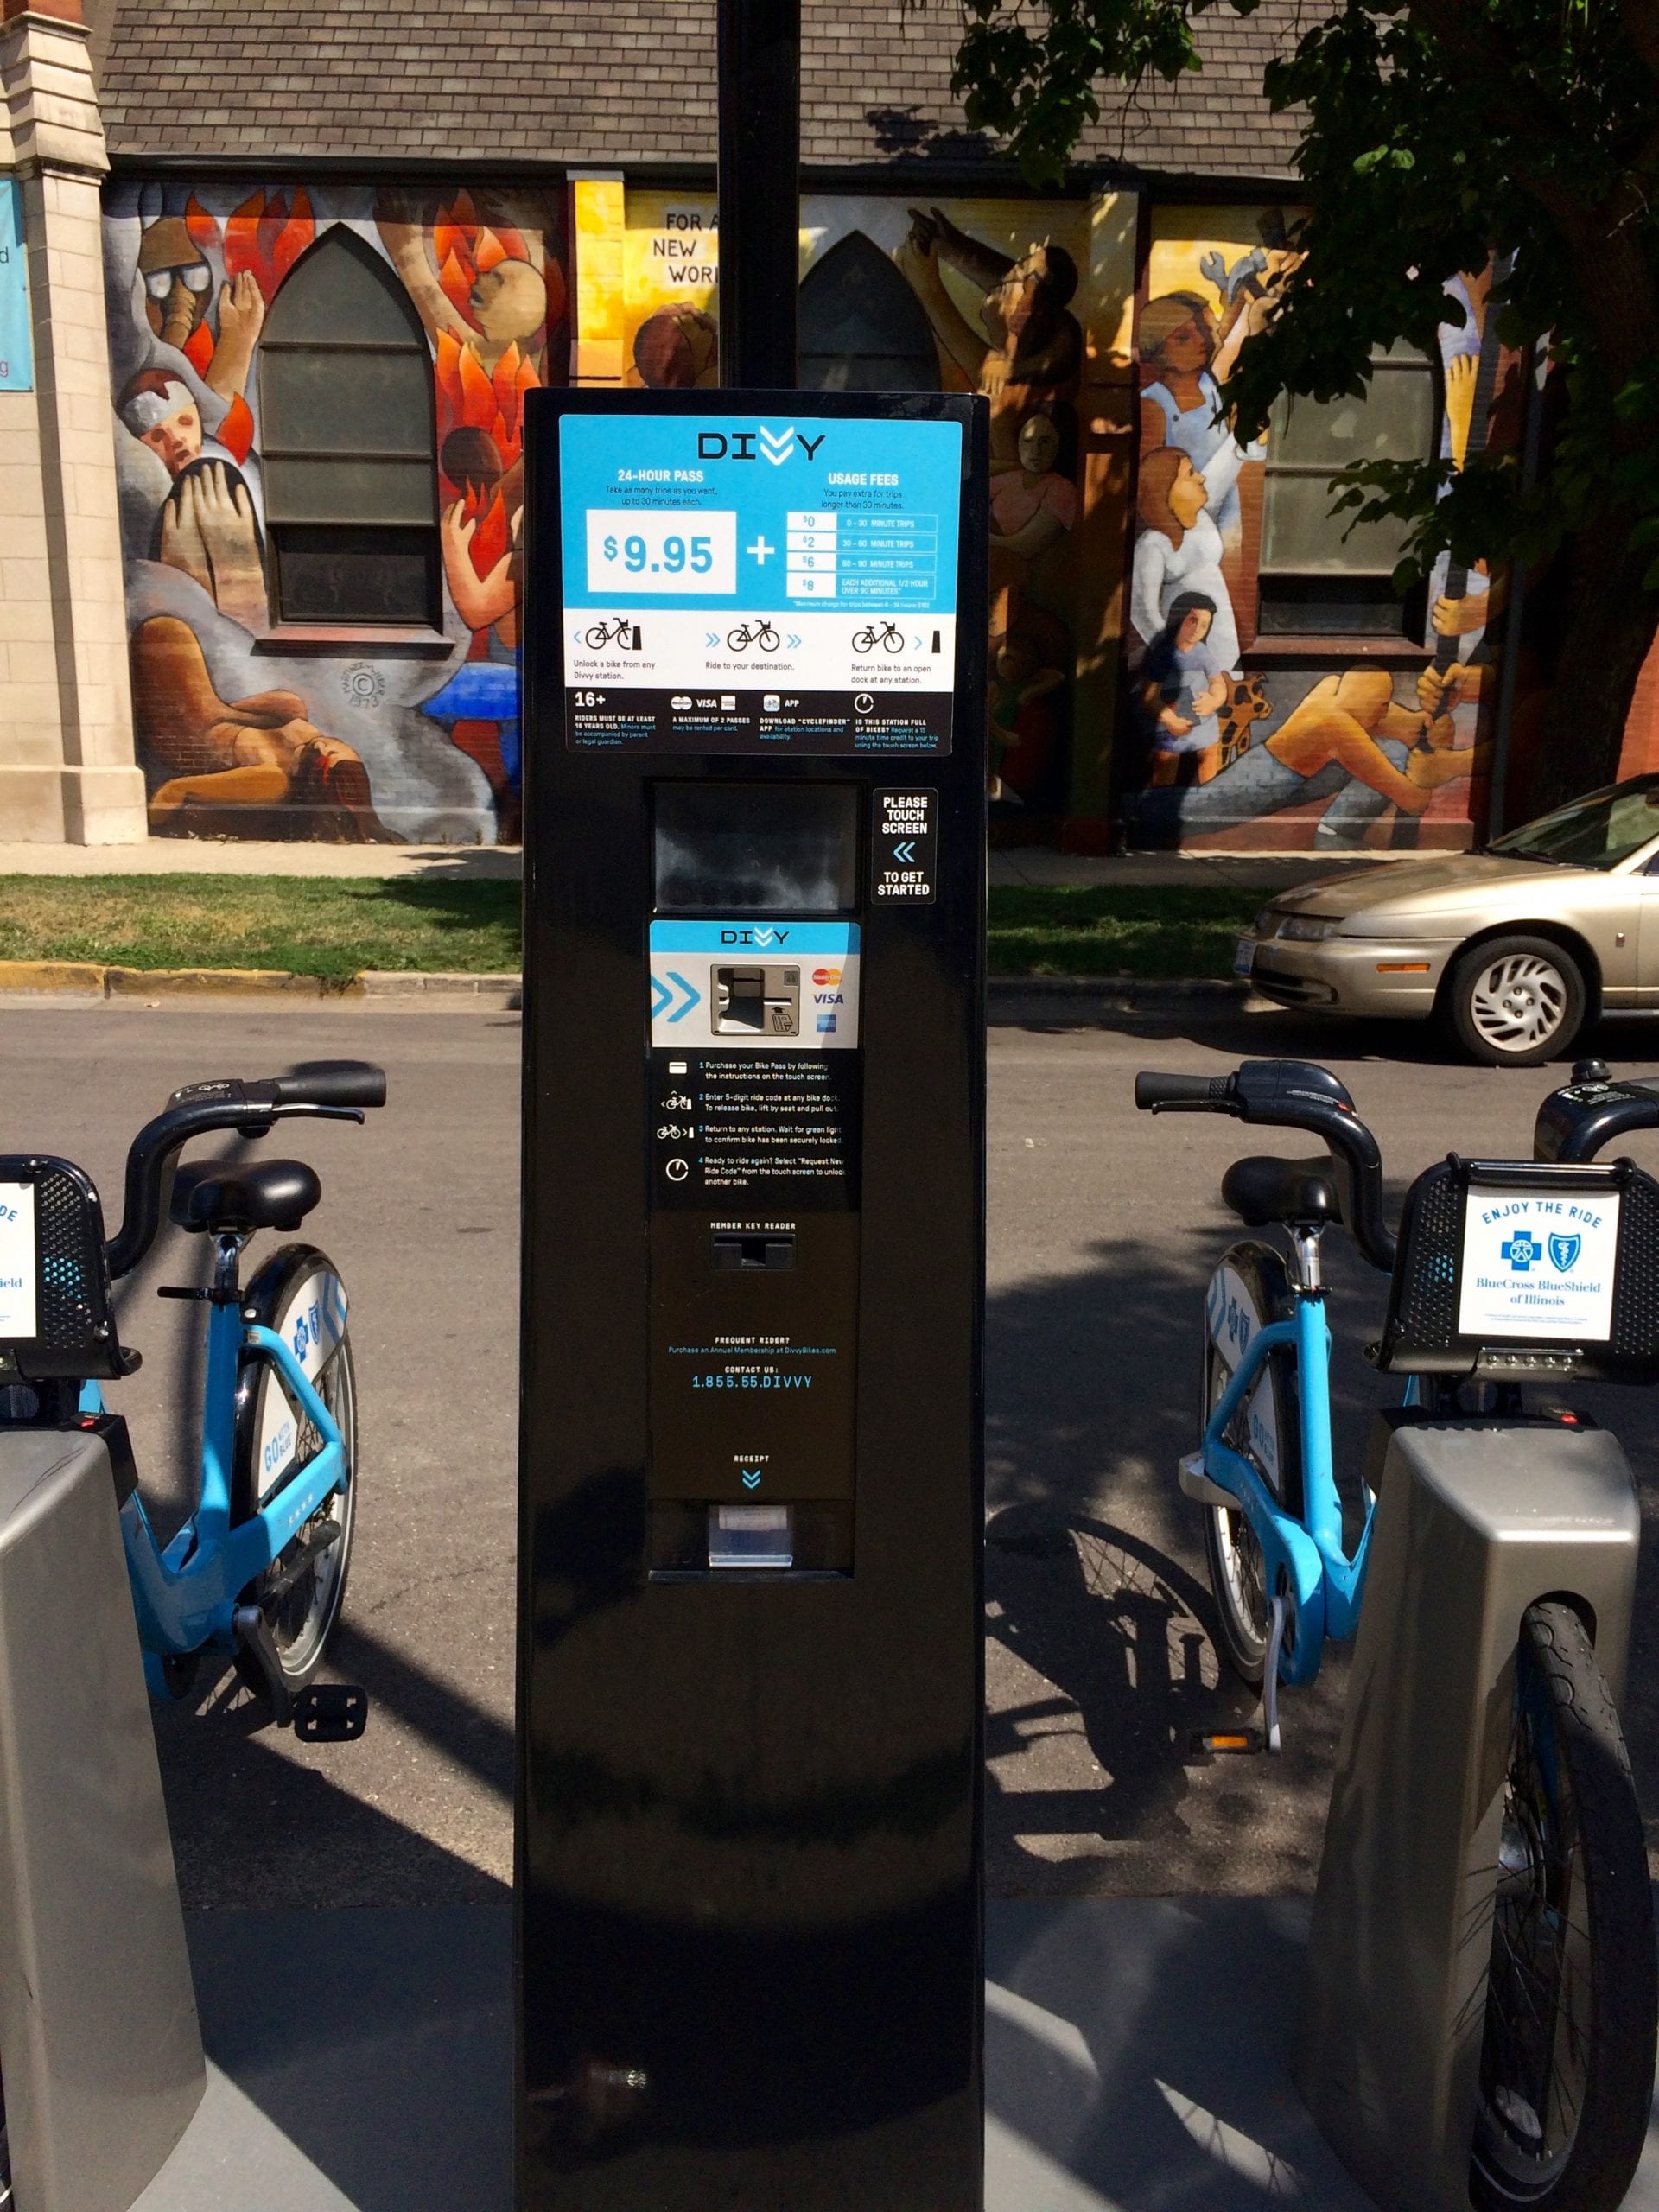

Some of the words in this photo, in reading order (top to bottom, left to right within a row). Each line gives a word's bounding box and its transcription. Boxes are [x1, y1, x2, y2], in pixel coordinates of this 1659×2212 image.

[666, 213, 702, 231] FOR
[653, 239, 696, 257] NEW
[669, 265, 719, 283] WOR
[617, 469, 671, 481] 24-HOUR
[673, 470, 704, 482] PASS
[828, 472, 867, 485] USAGE
[869, 474, 899, 486] FEES
[605, 485, 623, 493] Take
[654, 486, 672, 495] trips
[823, 488, 837, 497] You
[873, 489, 885, 498] for
[885, 490, 902, 499] trips
[652, 496, 681, 505] minutes
[821, 499, 843, 510] longer
[803, 515, 815, 528] $0
[803, 536, 815, 548] $2
[603, 535, 713, 573] $9.95
[803, 556, 815, 568] $6
[803, 579, 814, 591] $8
[750, 662, 795, 671] destination.
[574, 671, 594, 680] Divvy
[575, 692, 606, 707] 16+
[696, 699, 717, 708] VISA
[883, 797, 927, 808] PLEASE
[887, 810, 924, 821] TOUCH
[881, 823, 927, 834] SCREEN
[884, 872, 899, 883] TO
[901, 872, 924, 883] GET
[878, 884, 930, 895] STARTED
[814, 994, 843, 1004] VISA
[725, 1093, 749, 1102] 5-digit
[704, 1156, 726, 1165] Ready
[798, 1157, 829, 1166] "Request
[1482, 1202, 1529, 1224] ENJOY
[1536, 1201, 1563, 1214] THE
[1569, 1205, 1603, 1229] RIDE
[1476, 1277, 1535, 1290] BlueCross
[1538, 1279, 1601, 1293] BlueShield
[1510, 1294, 1522, 1305] of
[1525, 1294, 1565, 1306] Illinois
[692, 1376, 812, 1388] 1.855.55.DIVVY
